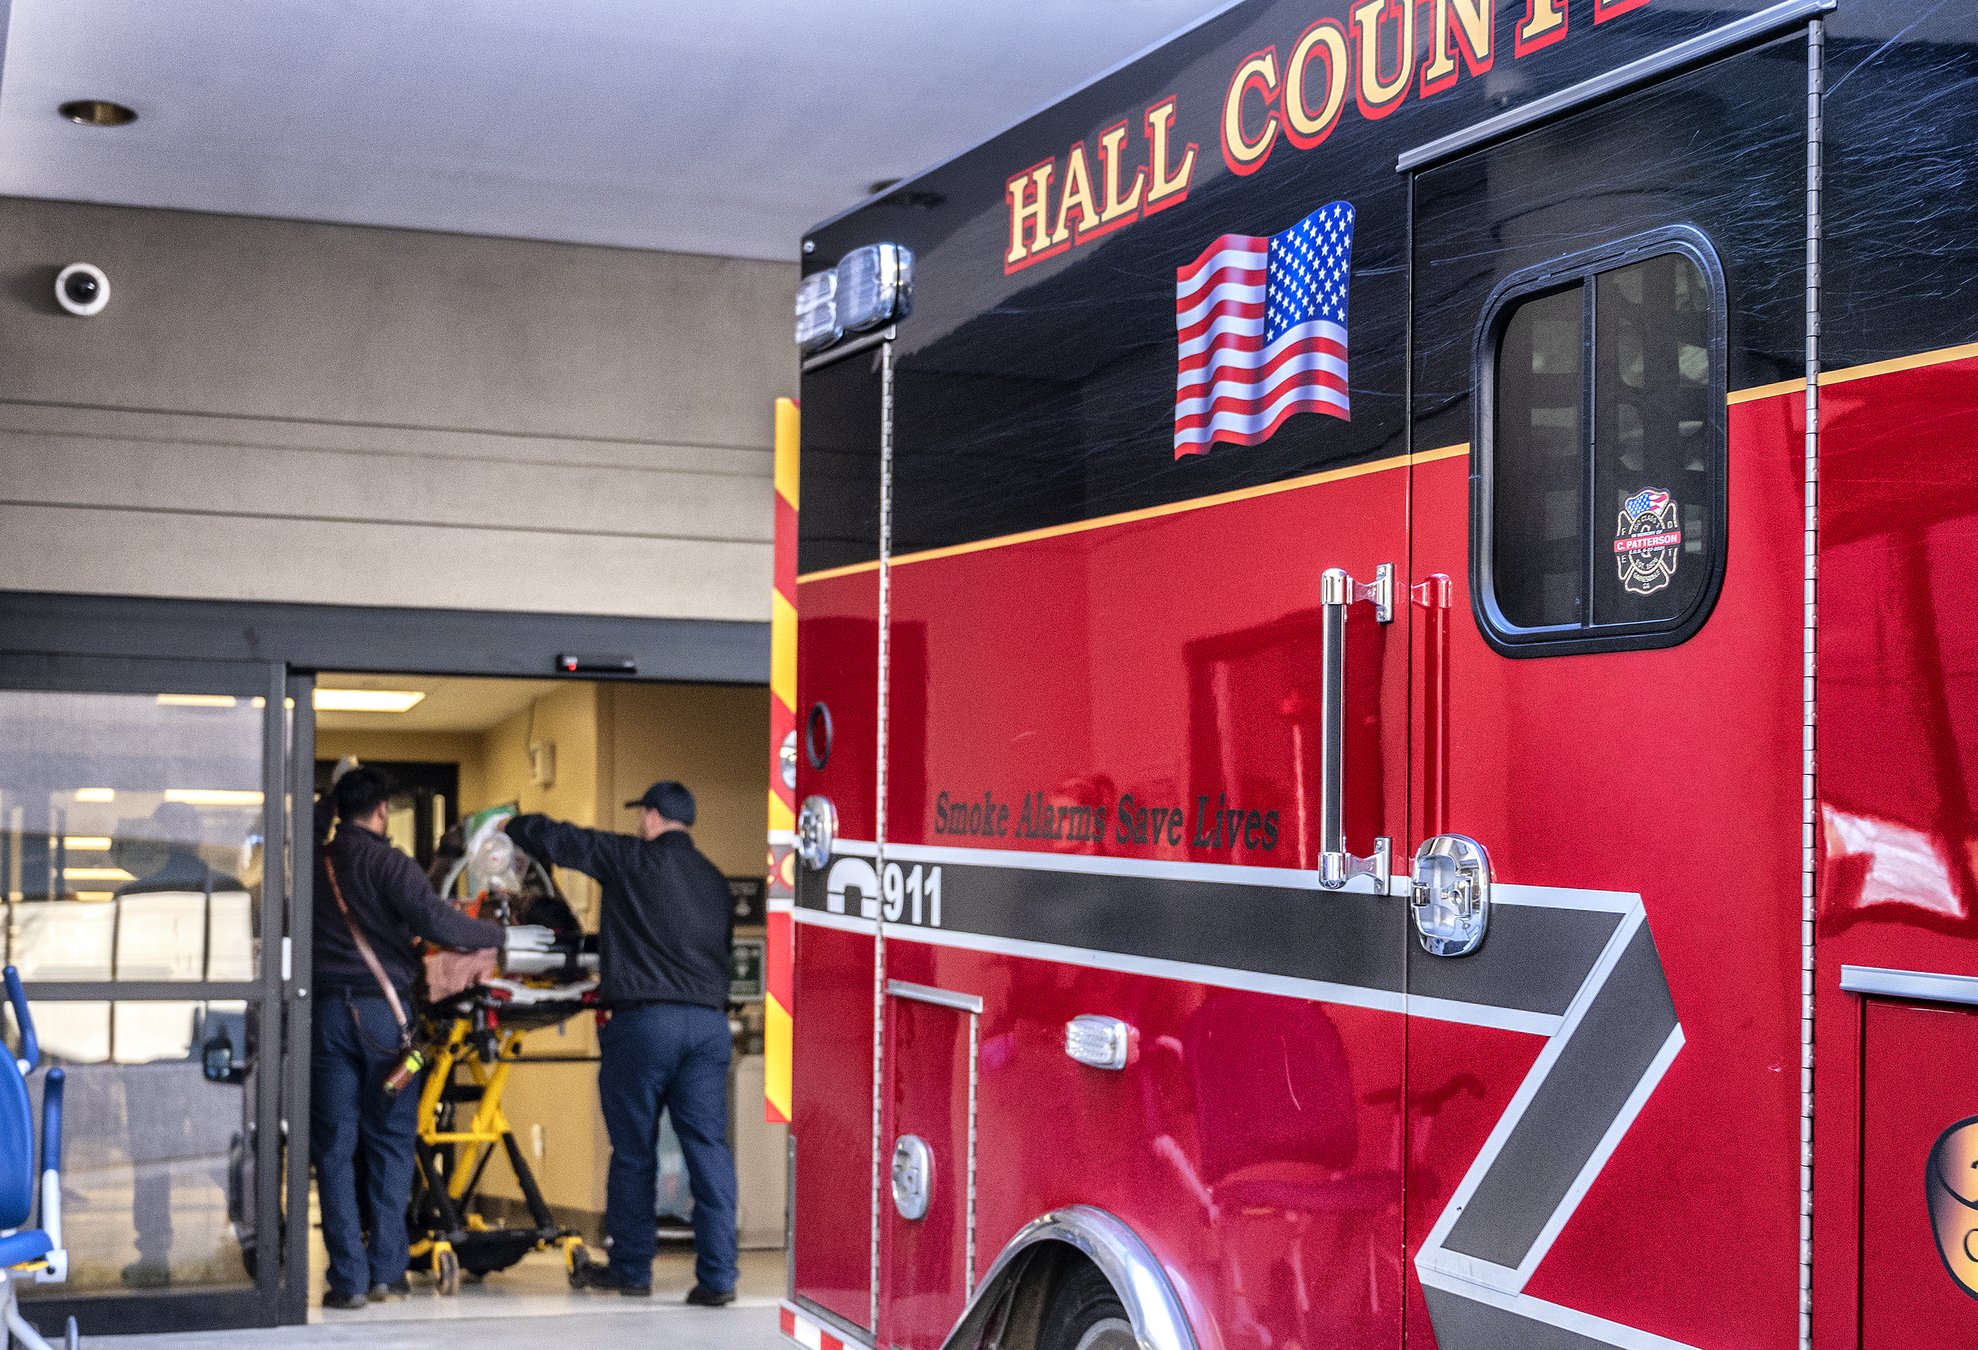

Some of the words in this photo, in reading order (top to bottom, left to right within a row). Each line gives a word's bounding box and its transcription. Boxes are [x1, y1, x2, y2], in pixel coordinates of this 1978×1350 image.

[1004, 94, 1199, 276] HALL
[1221, 0, 1652, 176] COUN
[1617, 542, 1626, 550] C.
[1626, 533, 1678, 548] PATTERSON
[934, 790, 1009, 837] Smoke
[1014, 790, 1107, 843] Alarms
[1115, 793, 1184, 846] Save
[1192, 791, 1279, 851] Lives
[882, 862, 942, 927] 911
